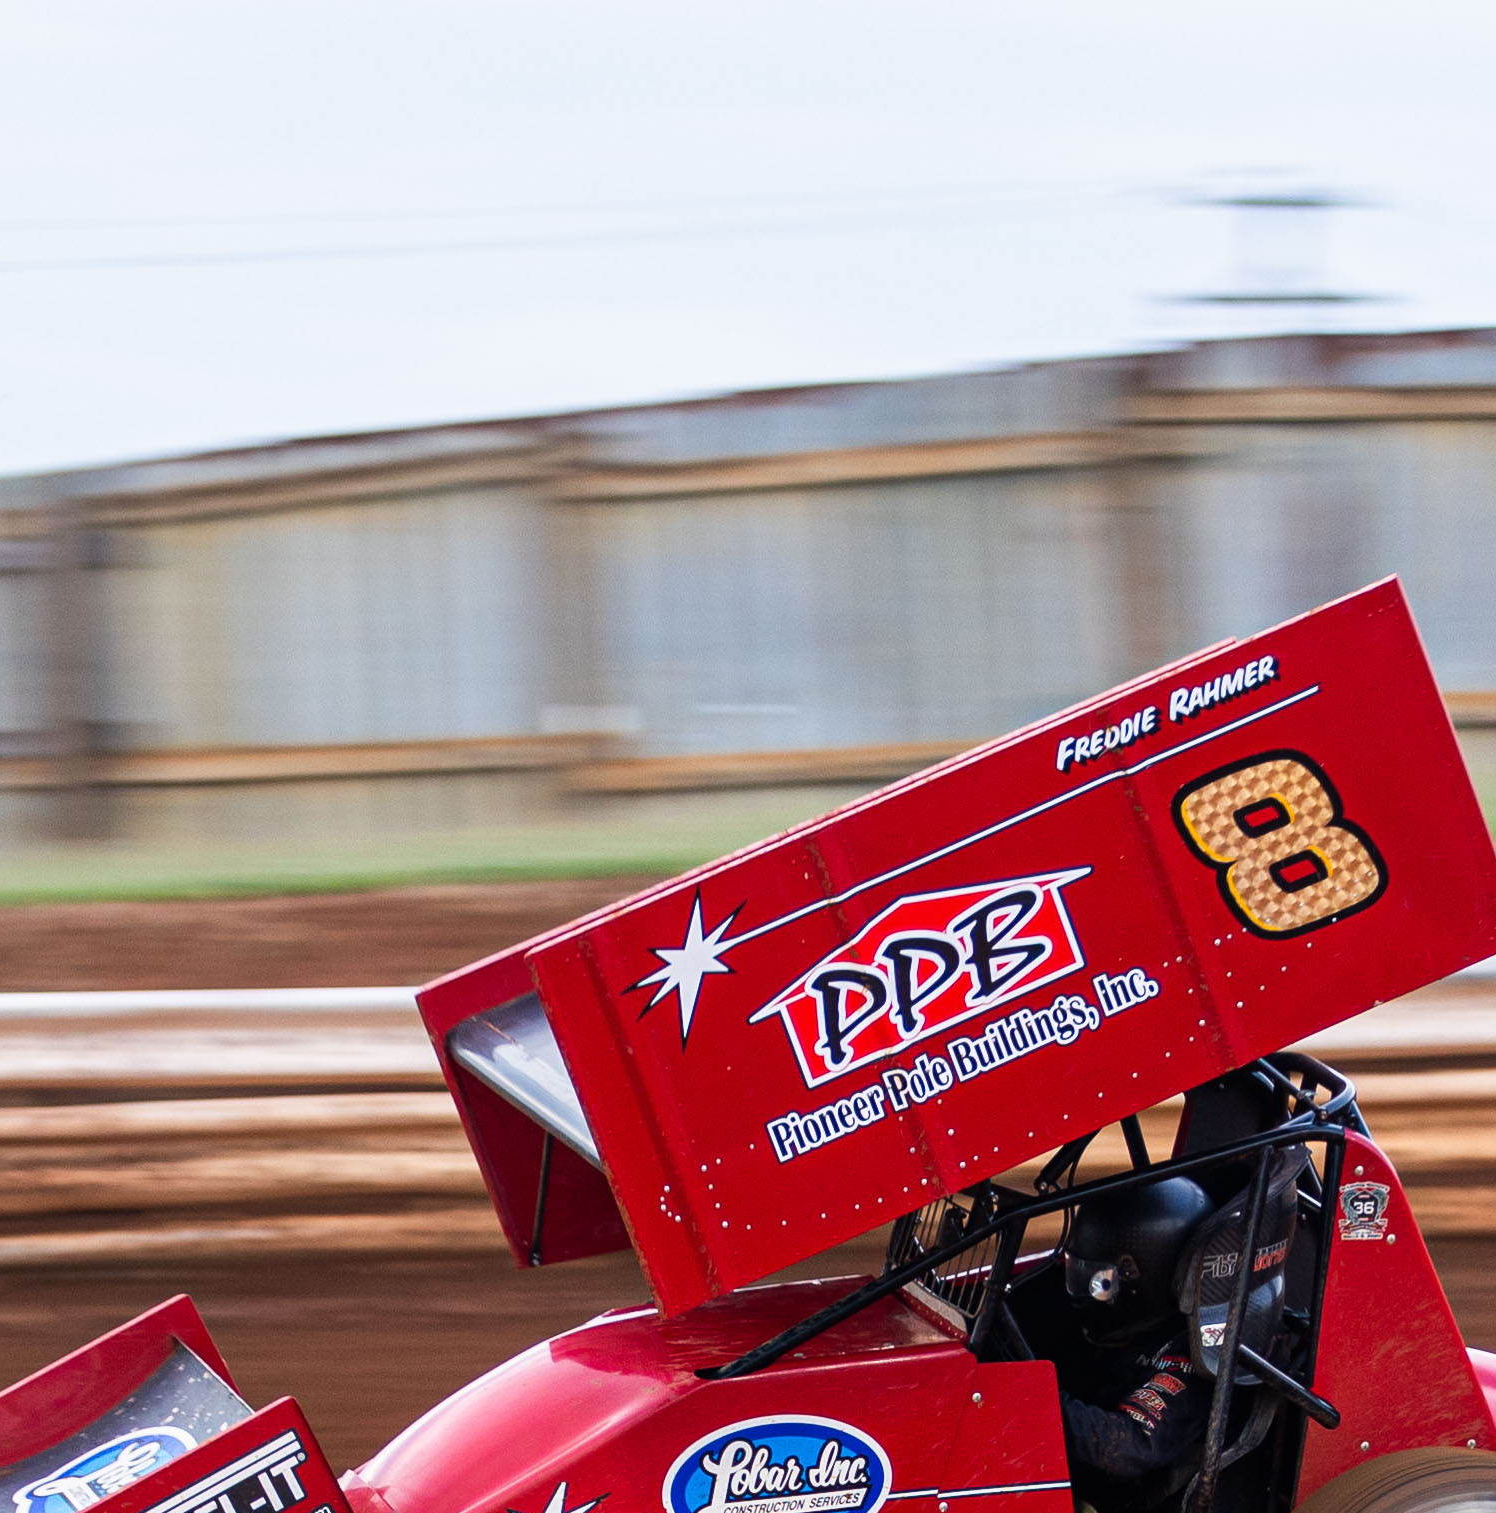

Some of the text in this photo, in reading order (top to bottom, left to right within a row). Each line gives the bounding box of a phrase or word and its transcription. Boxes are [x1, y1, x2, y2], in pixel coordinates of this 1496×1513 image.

[1056, 655, 1279, 772] FREDDIE RAHMER
[1170, 749, 1389, 940] 8
[805, 883, 1052, 1072] PPB
[766, 967, 1161, 1163] Pioneer Pole Buildings, Inc.
[1353, 1200, 1375, 1215] 36
[809, 1441, 867, 1488] Inc.
[809, 1492, 860, 1508] SERVICES
